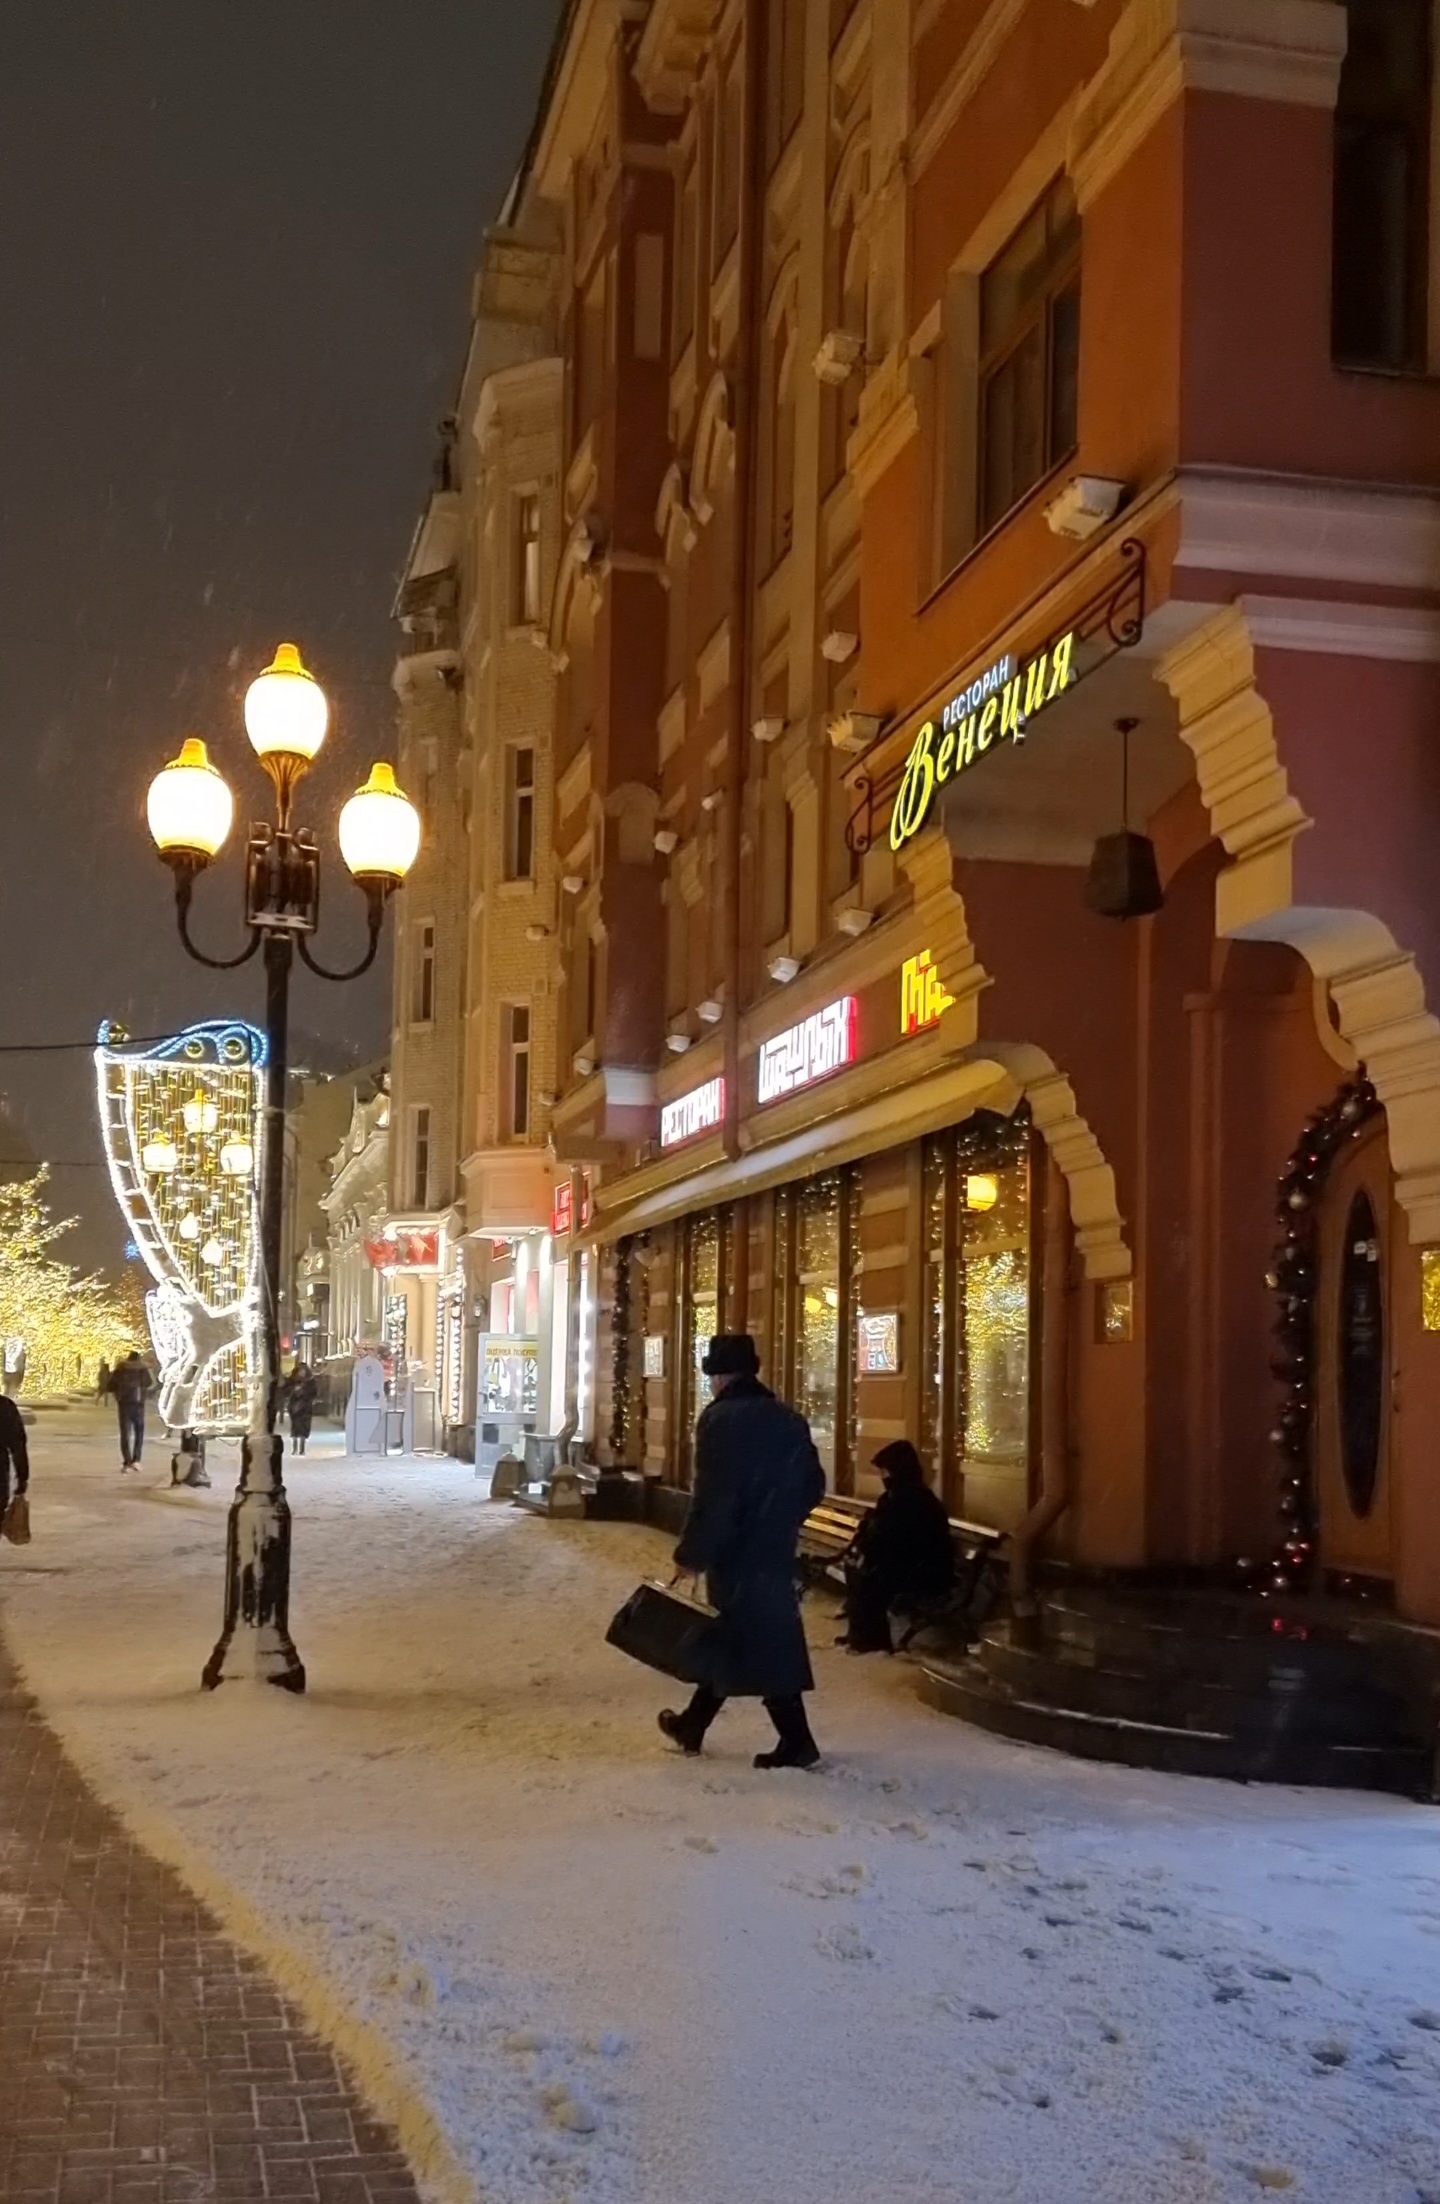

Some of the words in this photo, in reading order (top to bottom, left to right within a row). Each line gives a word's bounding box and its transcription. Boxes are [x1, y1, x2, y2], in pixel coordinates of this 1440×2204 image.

[943, 654, 1010, 730] РЕСТОРАН
[890, 631, 1073, 851] Венеция
[661, 1077, 723, 1147] РЕСТОРАН
